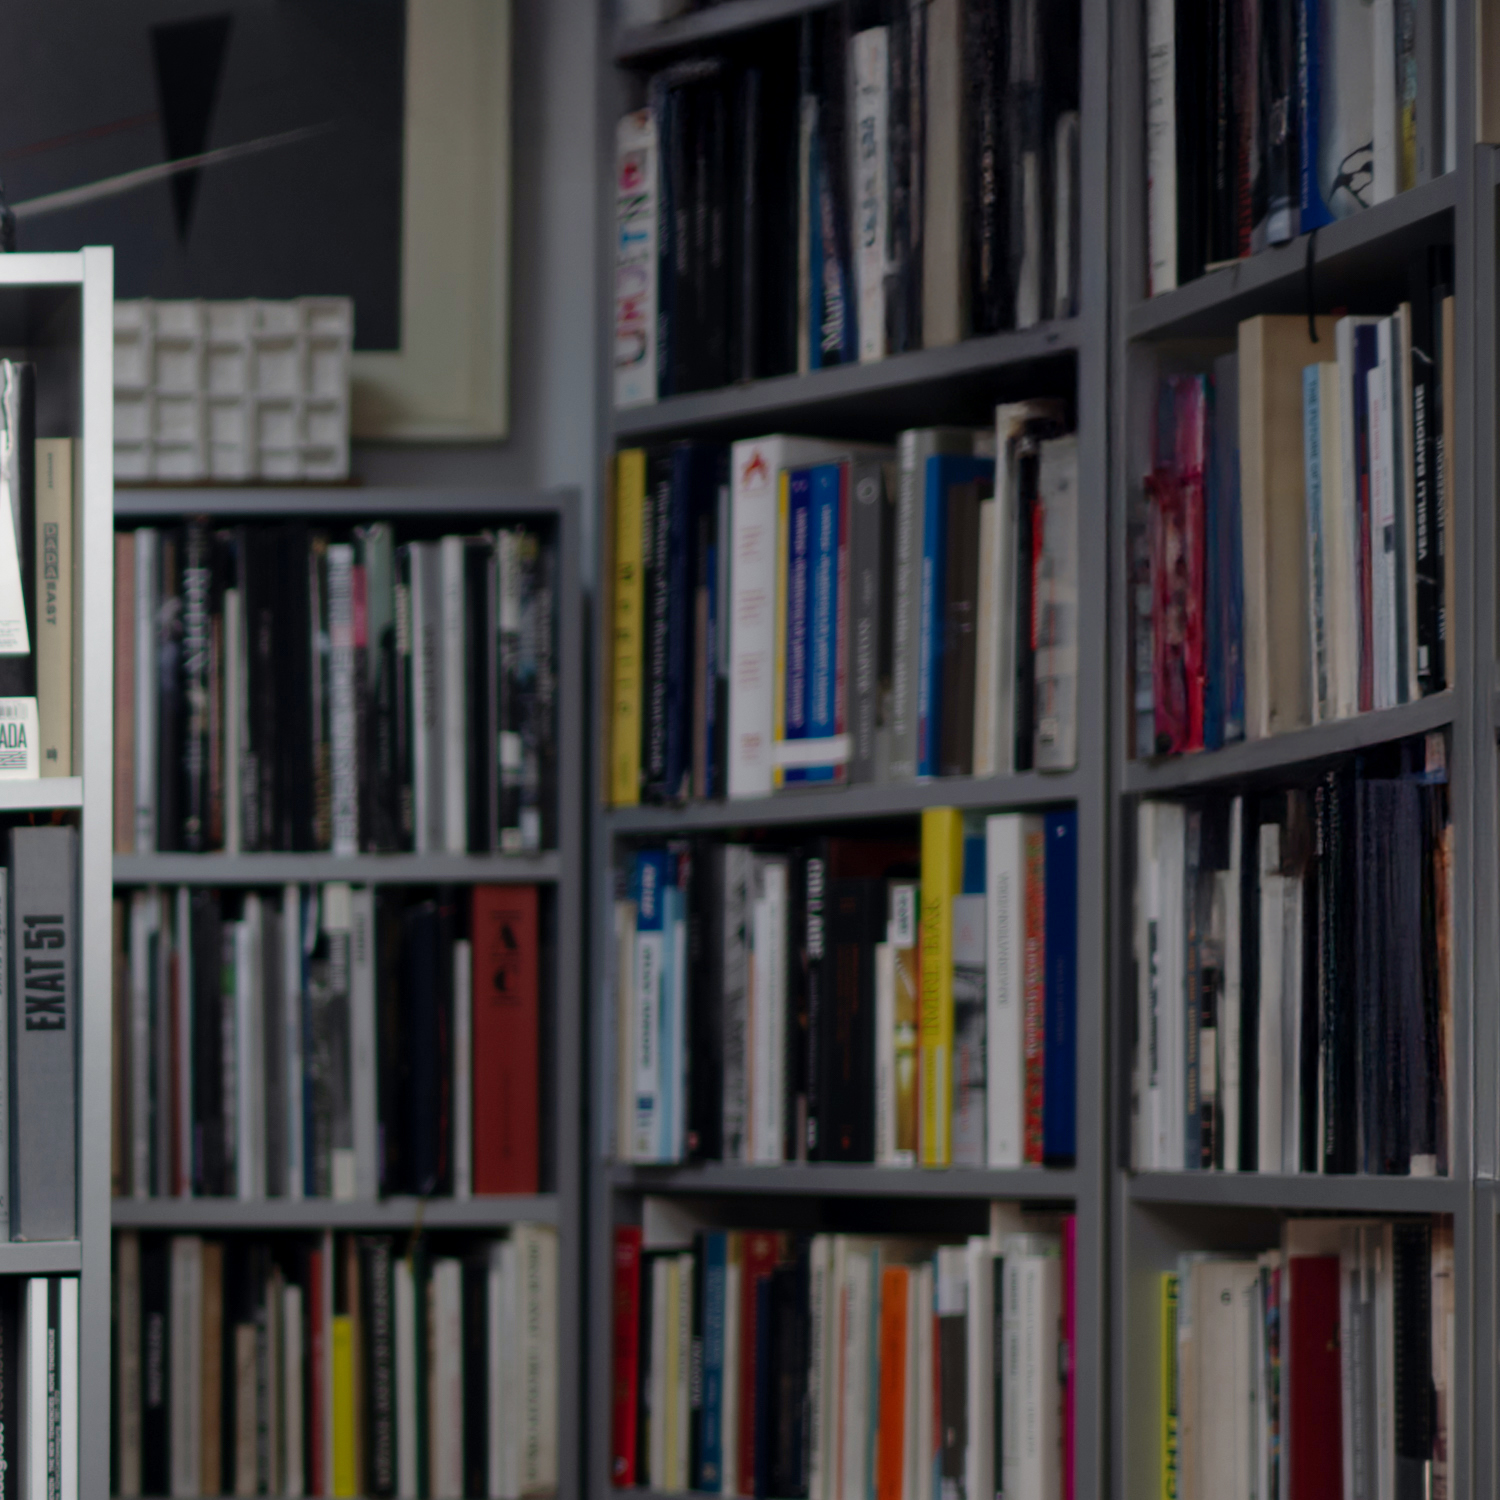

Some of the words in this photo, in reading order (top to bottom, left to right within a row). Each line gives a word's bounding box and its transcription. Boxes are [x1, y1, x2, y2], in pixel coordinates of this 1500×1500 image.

[1414, 383, 1426, 474] BANDIERE
[1416, 479, 1428, 560] VESSILLI
[24, 915, 66, 950] 51
[24, 958, 65, 1031] EXAT
